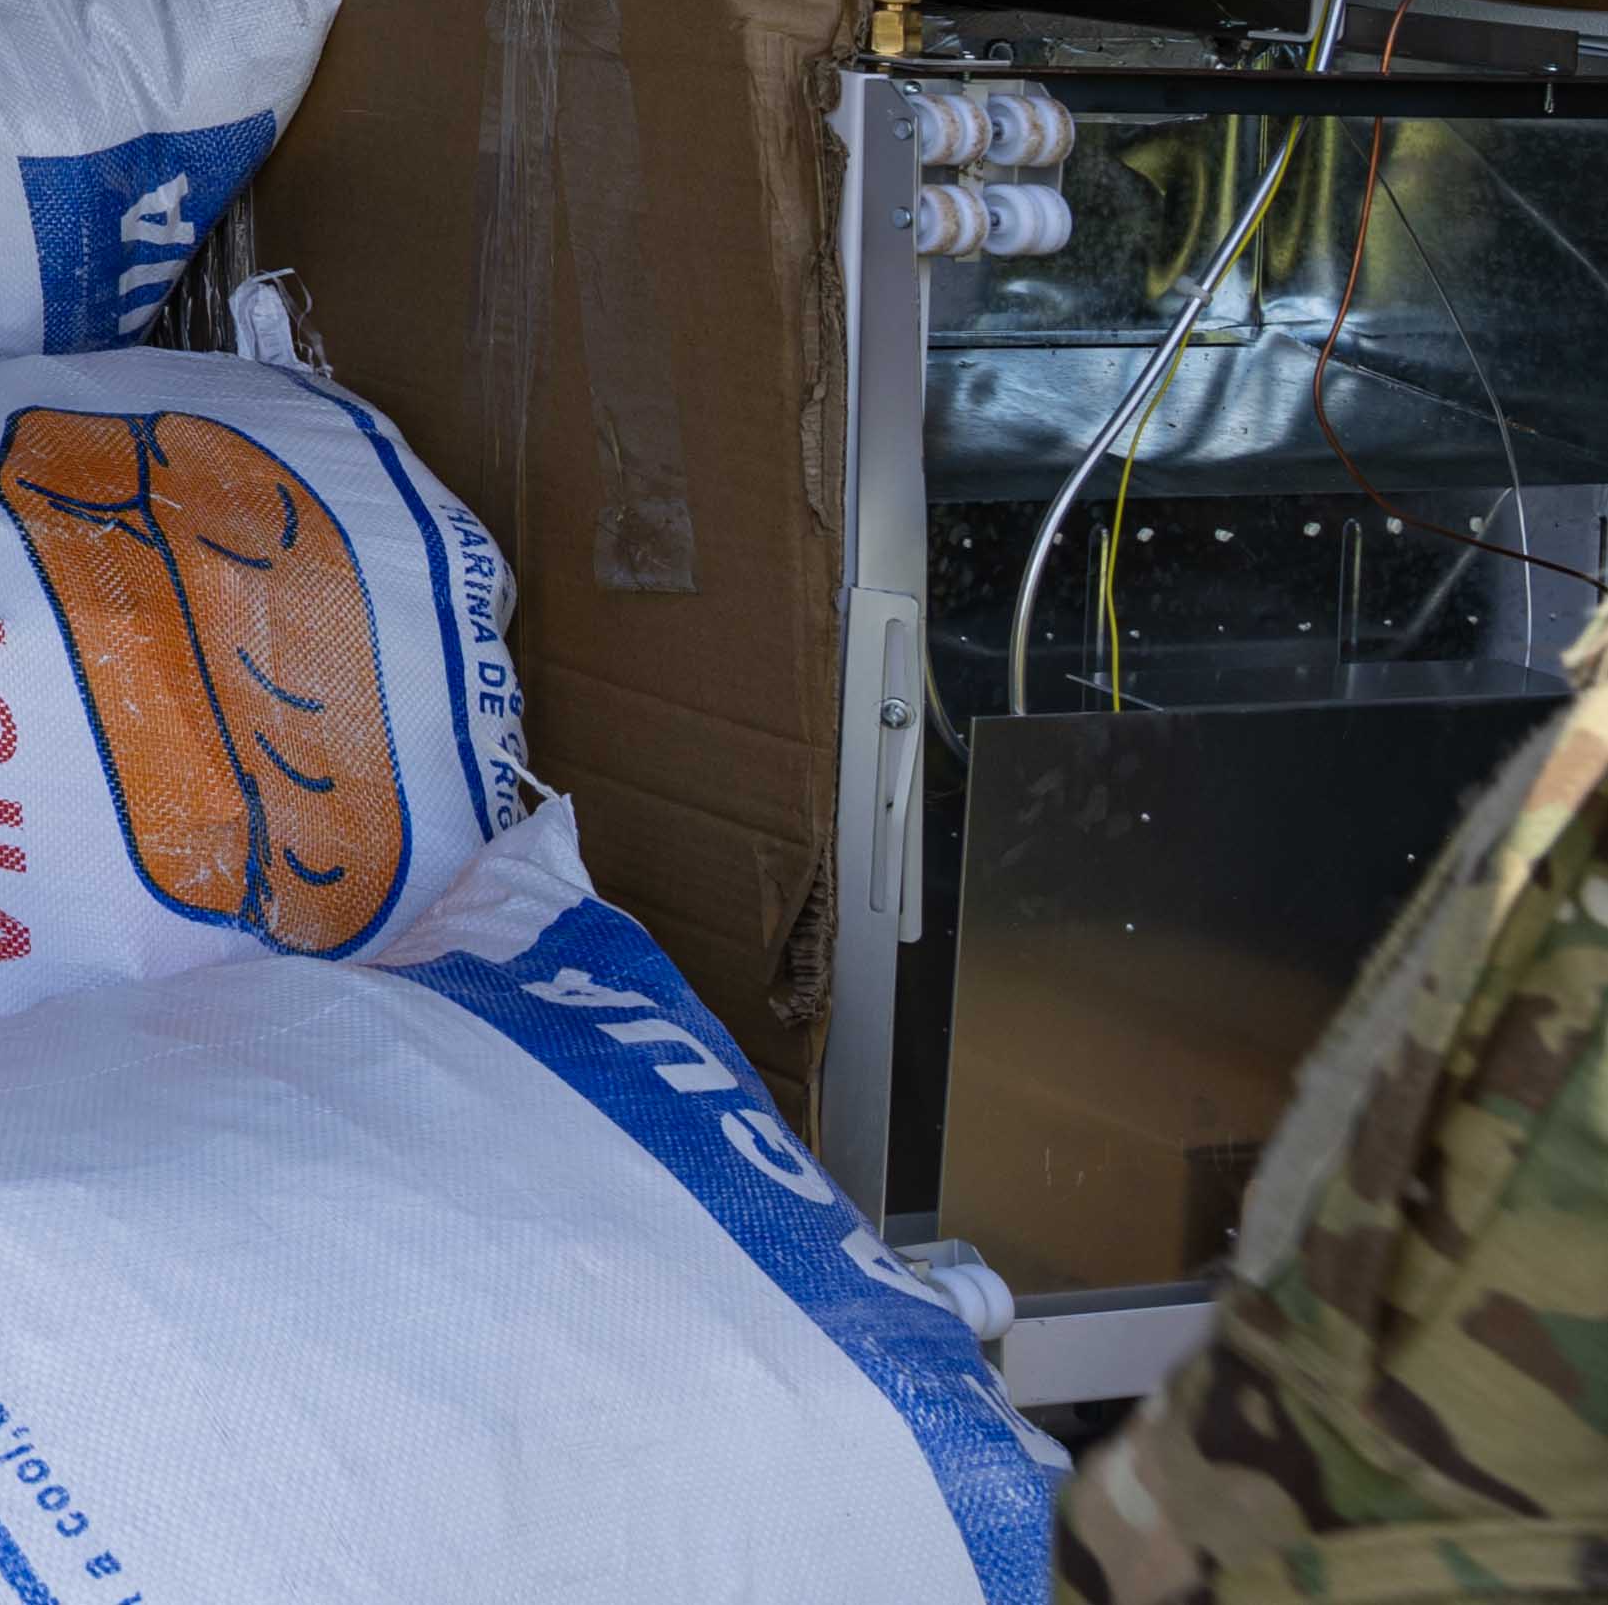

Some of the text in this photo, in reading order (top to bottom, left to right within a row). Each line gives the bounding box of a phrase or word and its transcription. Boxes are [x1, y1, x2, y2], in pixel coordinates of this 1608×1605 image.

[118, 172, 195, 336] UA
[438, 500, 500, 645] HARINA
[476, 659, 508, 719] DE
[85, 1551, 122, 1580] a
